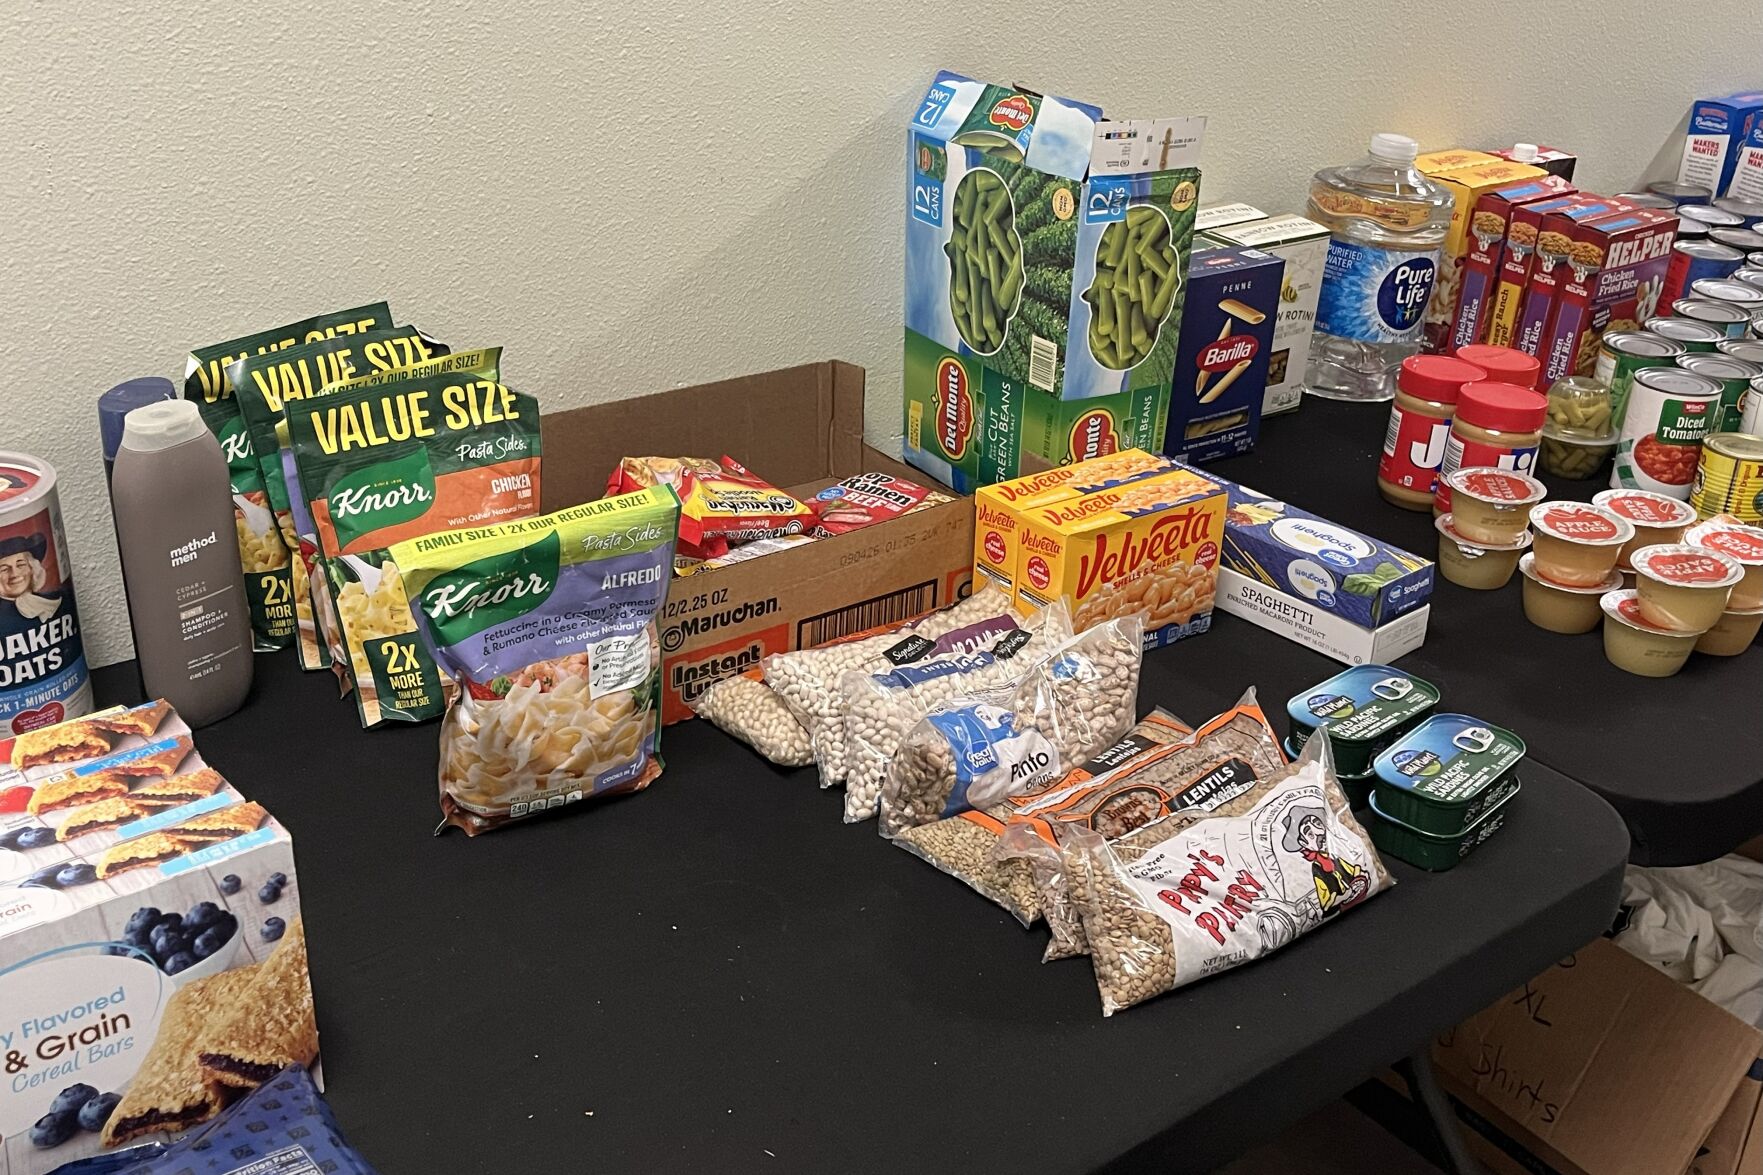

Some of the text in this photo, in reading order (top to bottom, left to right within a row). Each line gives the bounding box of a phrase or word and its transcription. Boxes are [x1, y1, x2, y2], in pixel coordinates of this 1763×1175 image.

[929, 89, 950, 103] CANS
[920, 102, 942, 125] 12
[1692, 146, 1719, 157] WANTED
[1693, 138, 1720, 149] MAKERS
[915, 186, 931, 215] 12
[930, 187, 940, 220] CANS
[1089, 191, 1114, 216] 12
[1111, 187, 1126, 216] CANS
[1327, 255, 1353, 269] WATER
[1328, 245, 1363, 261] PURIFIED
[1605, 231, 1674, 270] HELPER
[1223, 281, 1252, 294] PENNE
[1395, 266, 1433, 284] Pure
[1533, 274, 1556, 286] HELPER
[1598, 279, 1639, 296] Fried Rice
[1602, 270, 1635, 285] Chicken
[1396, 284, 1425, 308] Life
[1565, 284, 1588, 297] HELPER
[1286, 310, 1315, 322] ROTINI
[1469, 298, 1479, 319] Rice
[1499, 289, 1509, 321] Ranch
[1455, 305, 1470, 345] Chicken
[1533, 320, 1542, 341] Rice
[1204, 342, 1253, 366] Barilla
[1563, 332, 1573, 352] Rice
[412, 353, 480, 379] REGULAR SIZE!
[1547, 338, 1564, 380] Chicken
[252, 349, 356, 413] VALUE
[364, 335, 433, 375] SIZE
[311, 390, 435, 455] VALUE
[443, 381, 520, 430] SIZE
[945, 365, 959, 451] Del Monte
[958, 397, 969, 432] Quality
[1140, 395, 1153, 430] BEANS
[988, 408, 999, 441] CUT
[996, 382, 1012, 483] GREEN BEANS
[1676, 416, 1706, 429] Diced
[455, 433, 524, 462] Pasta Sides
[491, 473, 532, 495] CHICKEN
[840, 477, 912, 506] Ramen
[998, 469, 1075, 502] Velveeta
[332, 480, 429, 519] Knorr
[845, 492, 886, 509] BEEF
[1042, 492, 1122, 526] Velveeta
[415, 494, 650, 553] FAMILY SIZE 2X OUR REGULAR SIZE!
[447, 506, 517, 527] With Other Natural
[979, 504, 1018, 530] Velveeta
[1554, 520, 1603, 530] APPLE
[582, 521, 662, 552] Pasta Sides
[1021, 528, 1062, 555] Velveeta
[1291, 523, 1356, 552] Spaghetti
[1557, 525, 1612, 534] SAUCE
[170, 532, 217, 559] method
[1076, 504, 1213, 600] Velveeta
[171, 551, 198, 568] men
[1112, 552, 1181, 590] SHELLS & CHEESE
[1656, 558, 1713, 571] SAUCE
[1662, 564, 1715, 577] APPLE
[176, 582, 200, 595] CEDAR
[601, 564, 661, 591] ALFREDO
[1294, 567, 1328, 588] Spaghetti
[177, 586, 208, 602] CYPRESS
[427, 571, 549, 619] Knorr
[662, 588, 728, 619] 12/2.25 OZ
[1241, 586, 1314, 626] SPAGHETTI
[181, 611, 216, 629] SHAMPOO
[182, 612, 229, 634] CONDITIONER
[265, 604, 293, 620] MOR
[681, 597, 778, 637] Maruchan
[1227, 593, 1326, 640] ENRICHED MACARONI PRODUCT
[484, 606, 607, 644] Fettuccine in a Creamy
[554, 621, 634, 646] with other Natural
[483, 622, 579, 657] & Romano Cheese
[892, 637, 931, 661] Signature
[0, 648, 63, 688] OATS
[674, 645, 761, 688] Instant
[389, 671, 425, 690] MORE
[14, 686, 62, 711] 1-MINUTE
[395, 697, 418, 710] REGULAR
[397, 688, 423, 700] THAN OUR
[1330, 705, 1382, 733] WILD PACIFIC
[1339, 716, 1380, 738] SARDINES
[967, 747, 992, 764] Great
[972, 757, 997, 769] Value
[1091, 738, 1137, 764] LENTILS
[1104, 745, 1142, 767] Lentejas
[629, 763, 638, 776] 7
[1010, 752, 1049, 783] Pinto
[1423, 760, 1470, 793] WILD PACIFIC
[1025, 771, 1054, 791] Beans
[1182, 765, 1236, 807] LENTILS
[1433, 771, 1471, 798] SARDINES
[512, 804, 527, 812] 240
[1121, 811, 1151, 832] Best
[1151, 853, 1166, 867] Free
[1157, 849, 1225, 915] PAPY'S
[21, 986, 126, 1037] Flavored
[1514, 984, 1552, 1027] XL
[5, 1012, 132, 1075] & Grain
[12, 1034, 135, 1094] Cereal Bars
[1471, 1044, 1560, 1123] Shirts
[272, 1150, 304, 1165] Facts
